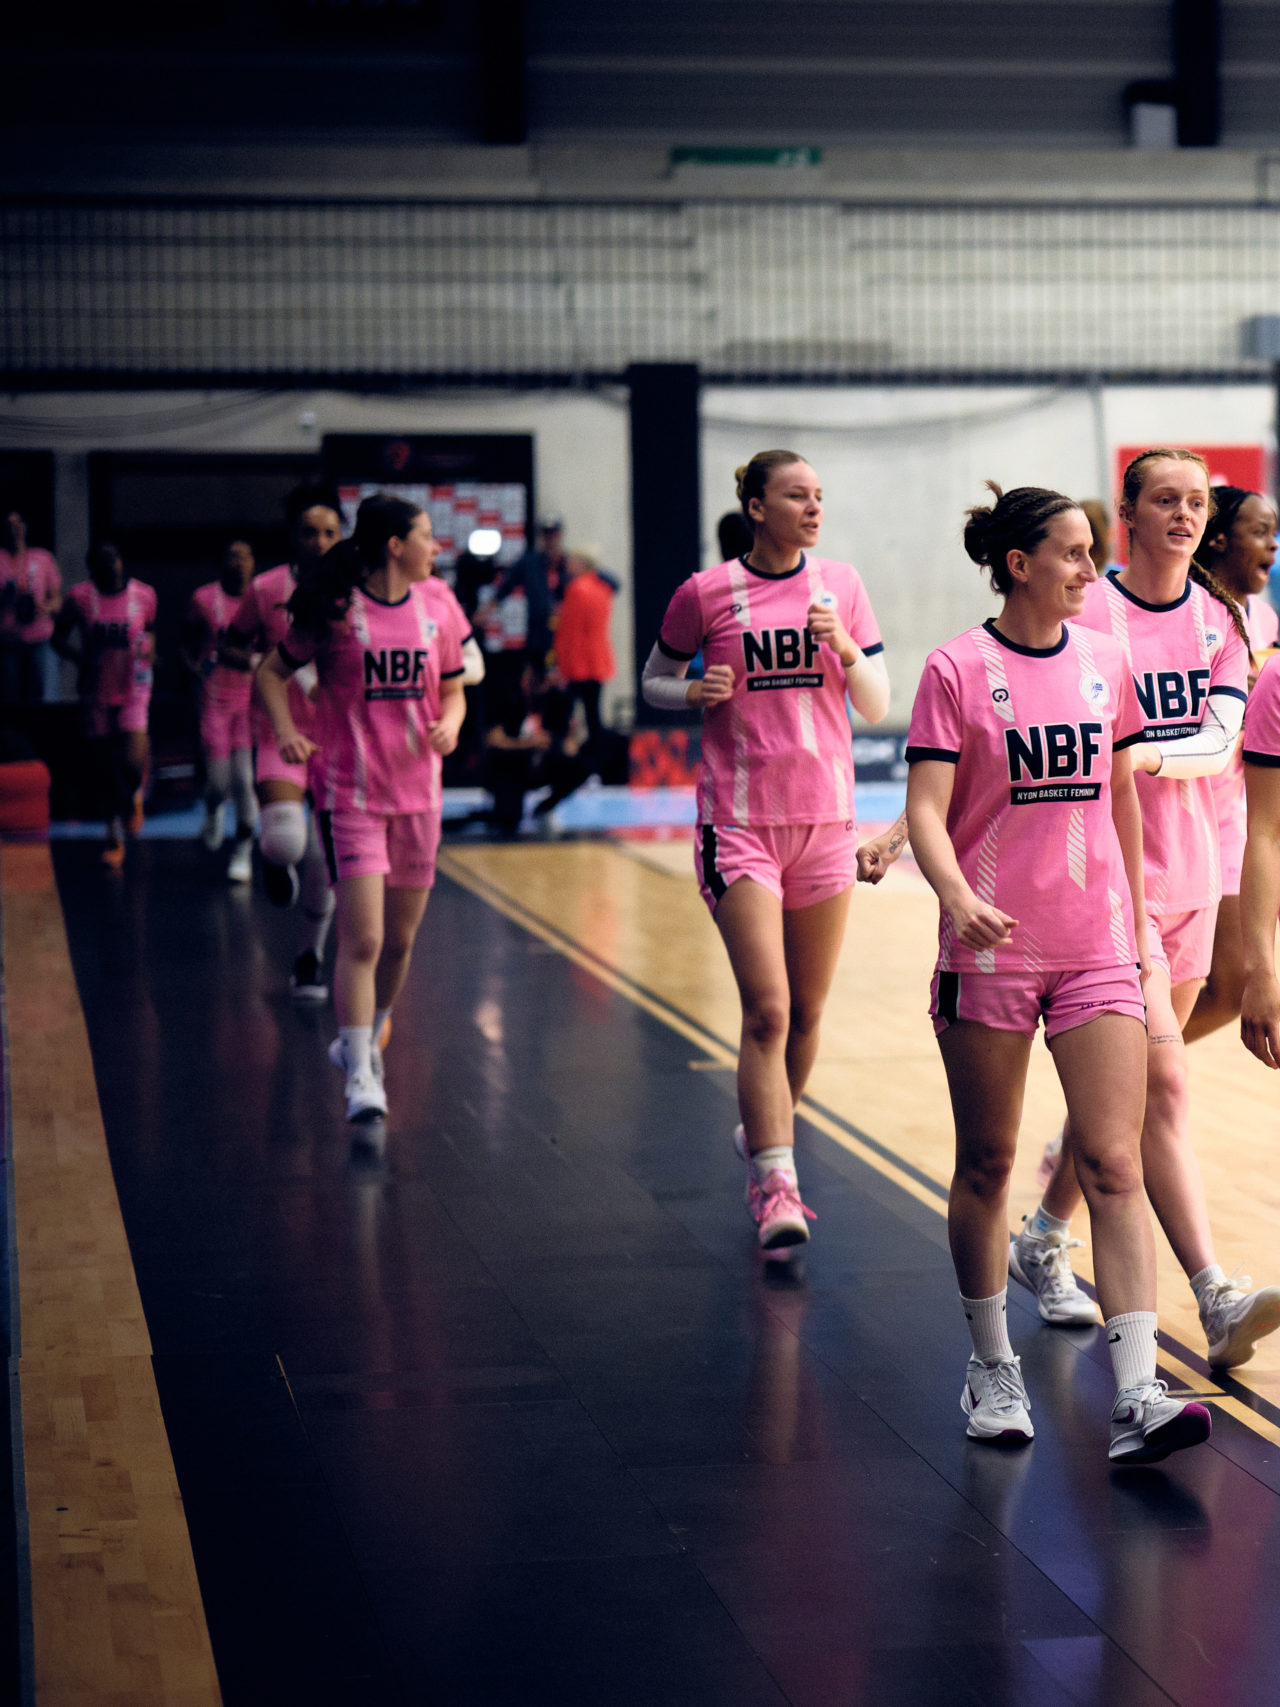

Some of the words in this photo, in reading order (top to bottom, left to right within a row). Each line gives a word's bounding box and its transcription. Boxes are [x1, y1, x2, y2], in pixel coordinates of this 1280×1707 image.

[363, 648, 428, 686] NBF
[742, 627, 820, 673] NBF
[1131, 669, 1210, 720] NBF
[1003, 722, 1103, 783] NBF
[1156, 727, 1181, 738] BASKET
[1017, 791, 1038, 800] NYON
[1039, 788, 1069, 798] BASKET
[1070, 787, 1096, 797] FEMININ
